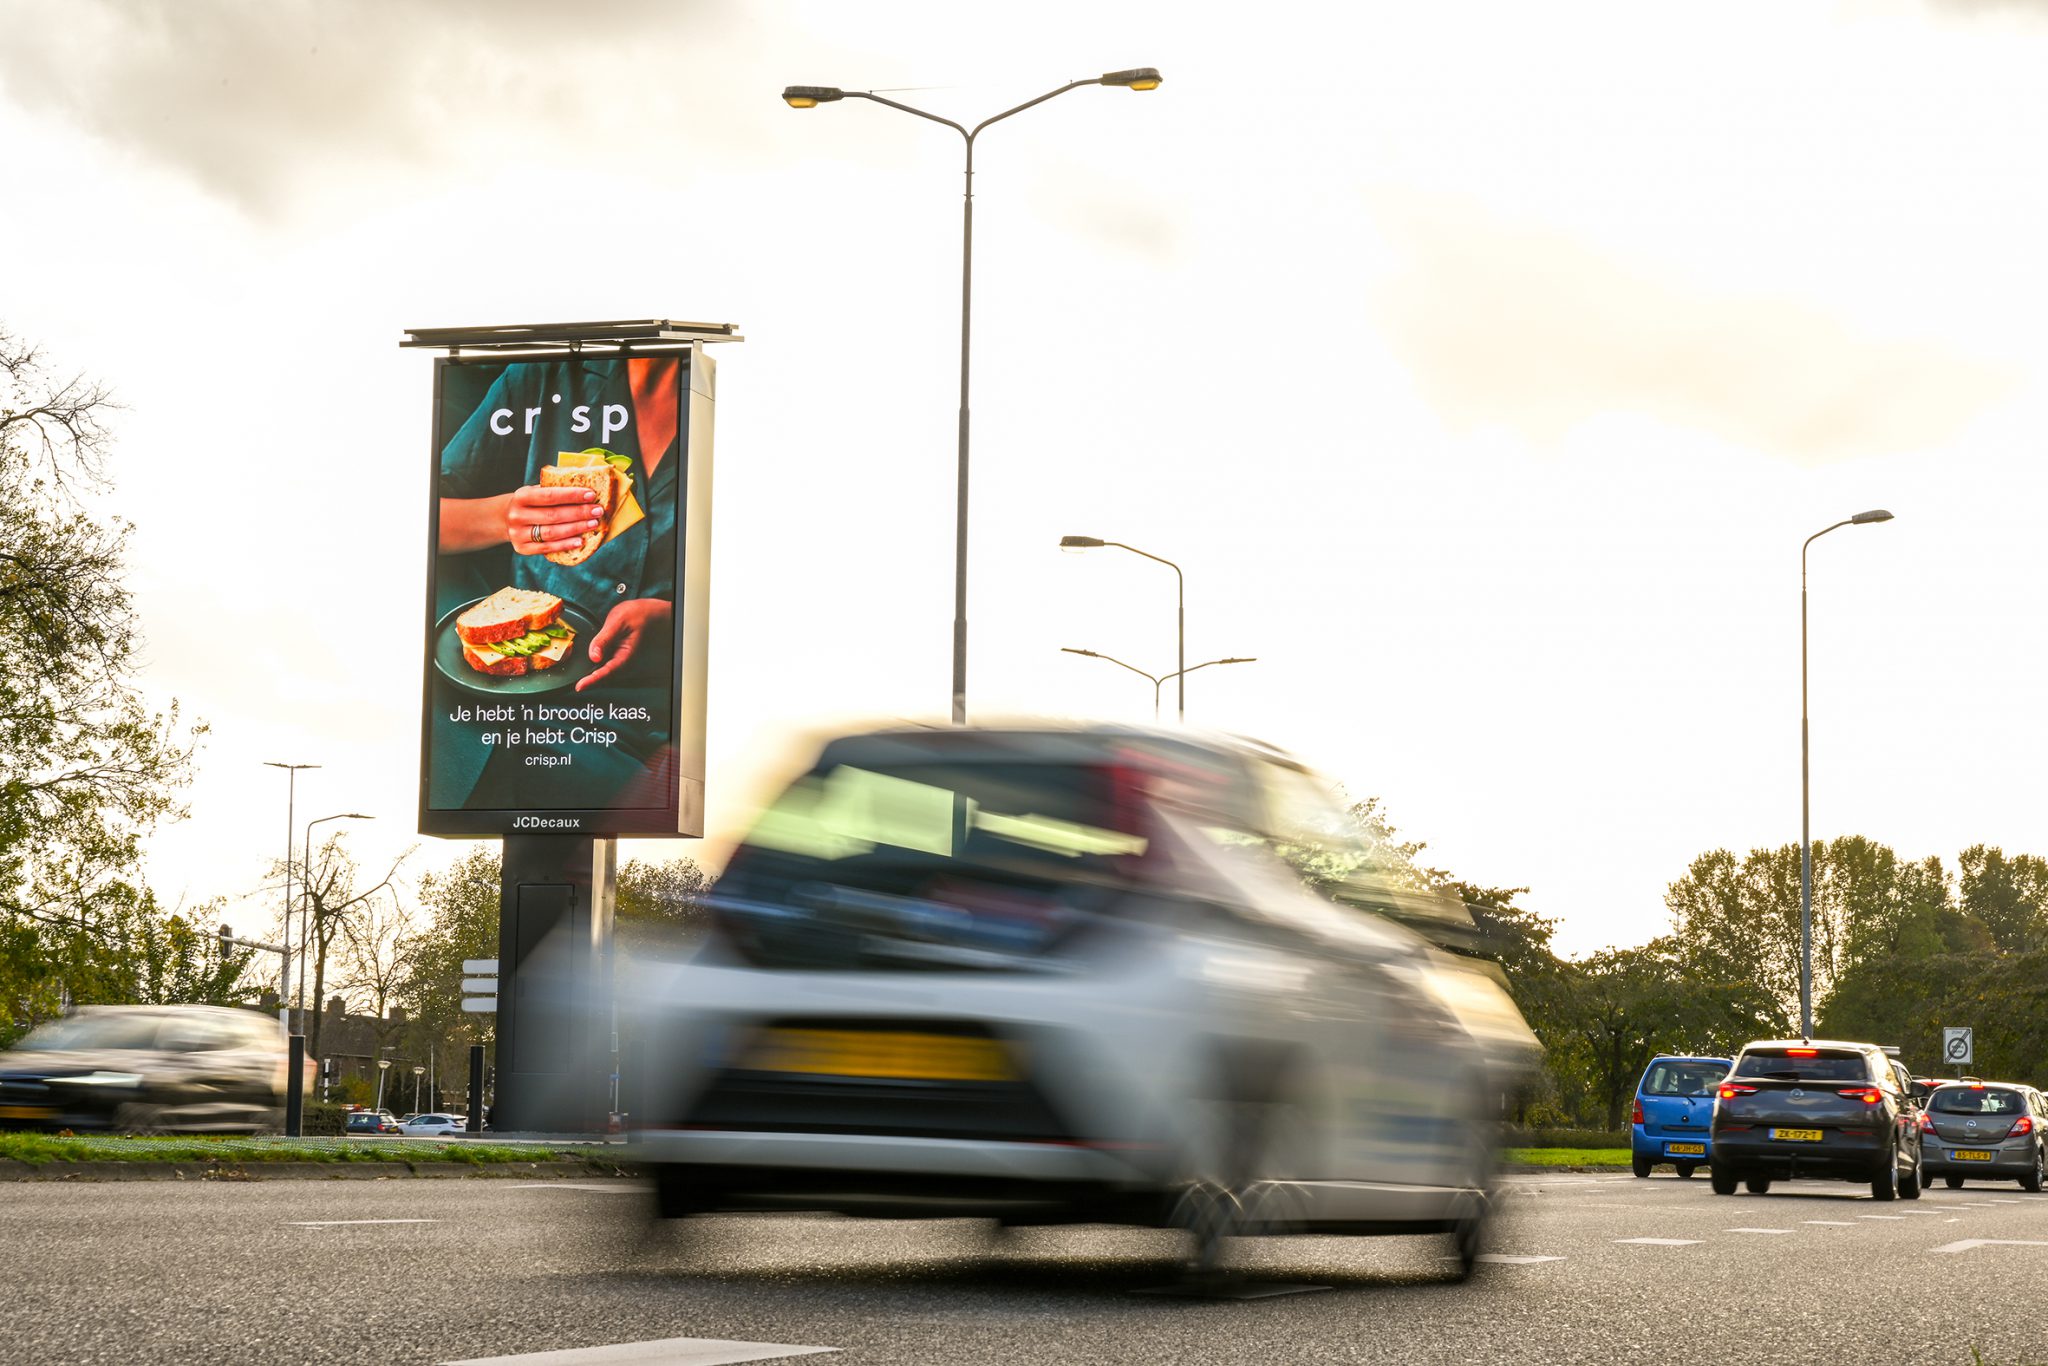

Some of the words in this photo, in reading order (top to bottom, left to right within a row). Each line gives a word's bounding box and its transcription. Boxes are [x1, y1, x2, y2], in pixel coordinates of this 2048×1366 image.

[449, 705, 471, 722] Je
[476, 704, 516, 722] hebt
[538, 703, 605, 724] broodje
[608, 702, 651, 722] kaas,
[481, 732, 502, 745] en
[506, 729, 521, 749] je
[525, 727, 566, 745] hebt
[570, 726, 618, 748] Crisp
[524, 753, 572, 769] crisp.nl
[512, 816, 581, 829] JCDecaux
